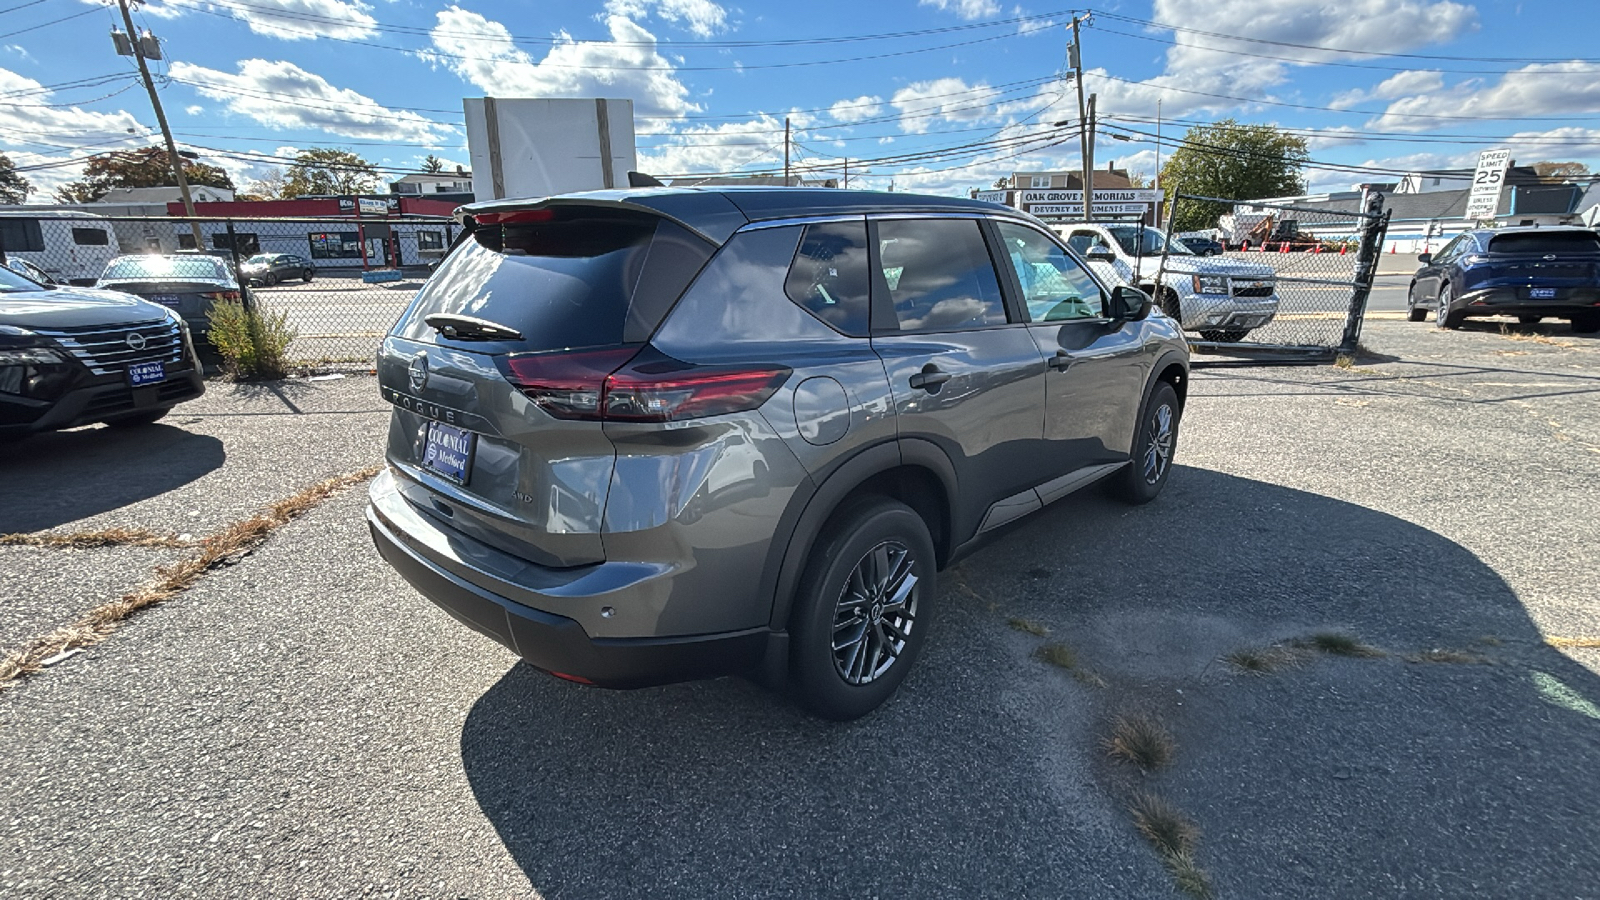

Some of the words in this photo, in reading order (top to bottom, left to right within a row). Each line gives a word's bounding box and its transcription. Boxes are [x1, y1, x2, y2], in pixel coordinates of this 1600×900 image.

[1481, 160, 1503, 168] LIMIT
[1476, 169, 1502, 184] 25
[1025, 193, 1046, 201] OAK
[1047, 193, 1078, 201] GROVE
[1072, 205, 1123, 213] MOUMENTS
[393, 393, 455, 422] ROGUE
[428, 428, 469, 455] COLONIAL
[438, 449, 466, 471] Medford
[511, 491, 533, 503] AWD
